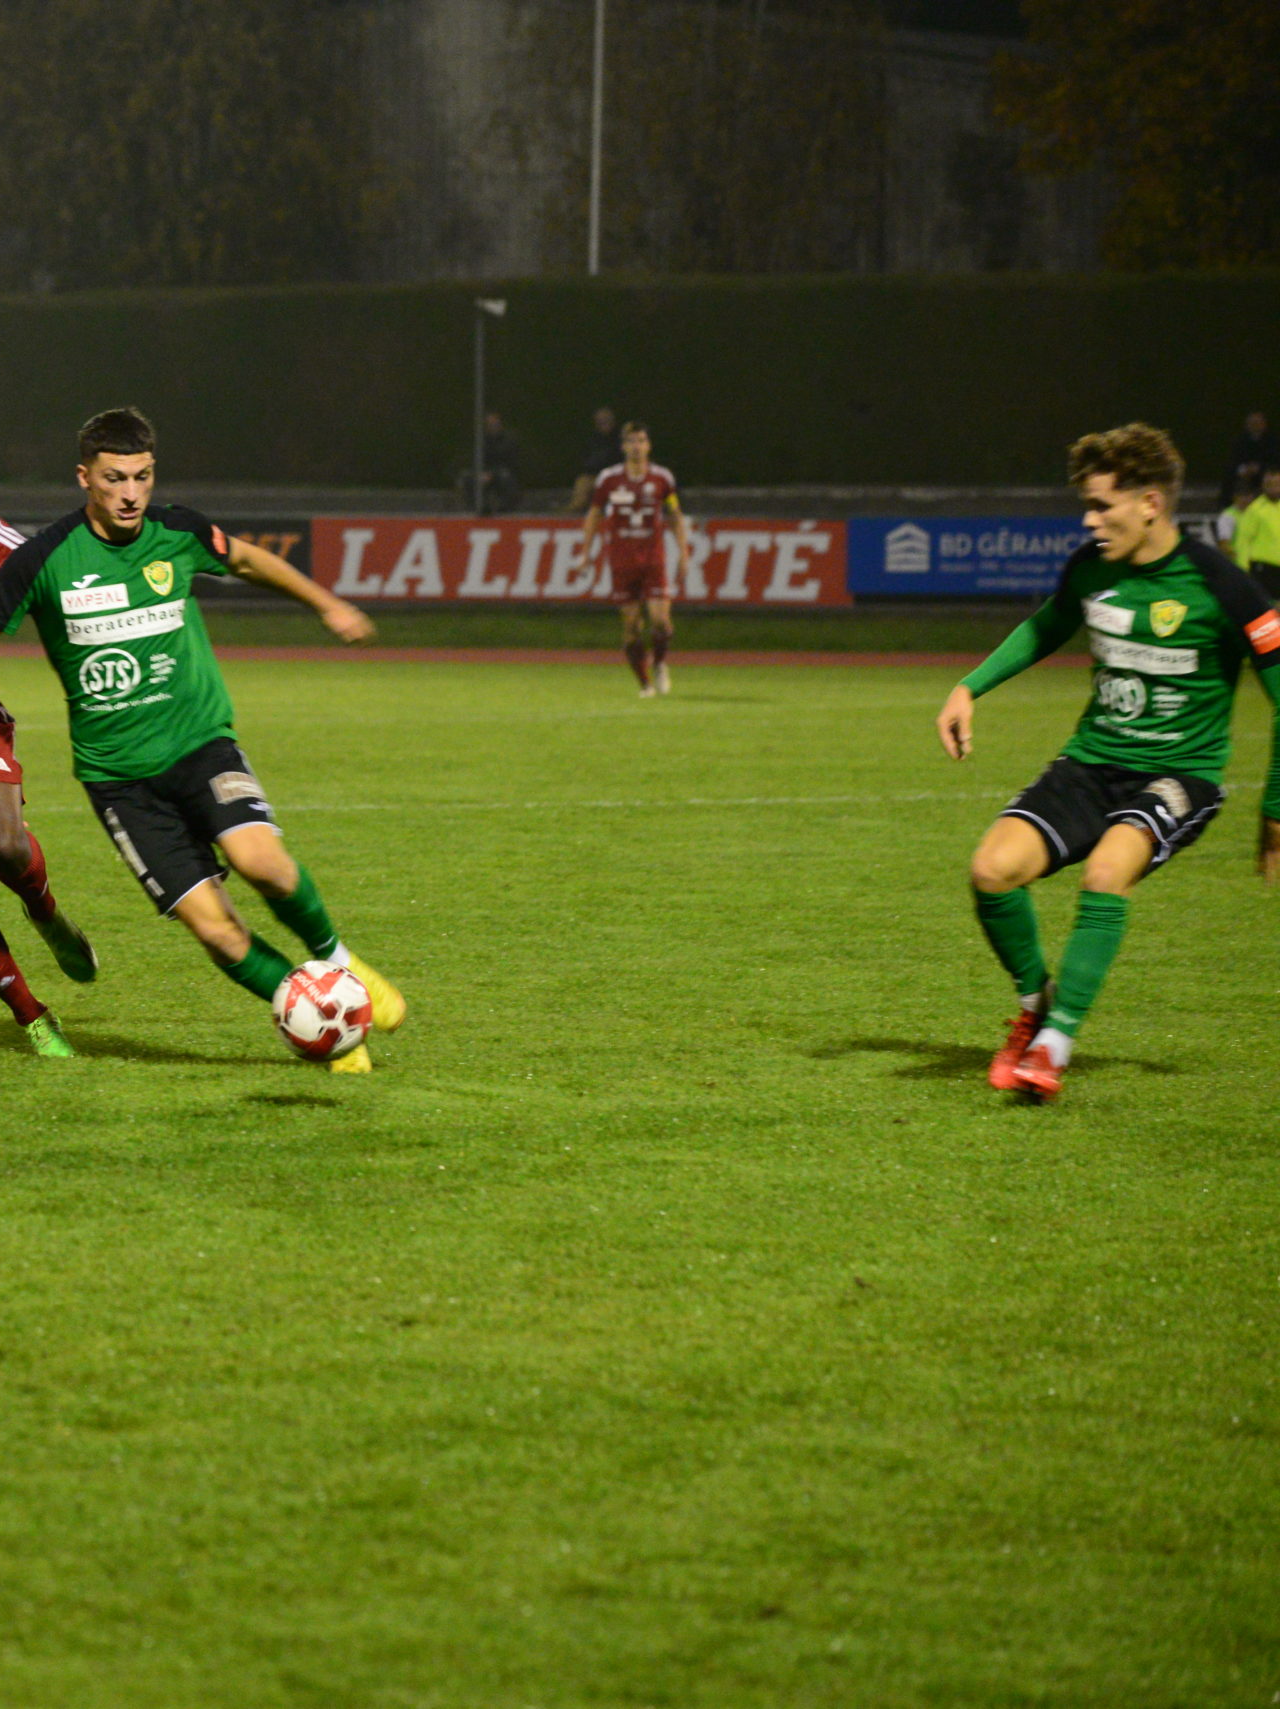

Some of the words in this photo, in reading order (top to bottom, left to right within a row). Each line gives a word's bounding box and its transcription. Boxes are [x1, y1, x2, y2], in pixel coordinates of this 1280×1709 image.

[333, 528, 444, 595] LA
[458, 520, 830, 600] LIBRTÉ
[939, 532, 972, 558] BD
[65, 592, 124, 608] YAPEAL
[88, 659, 132, 693] STS
